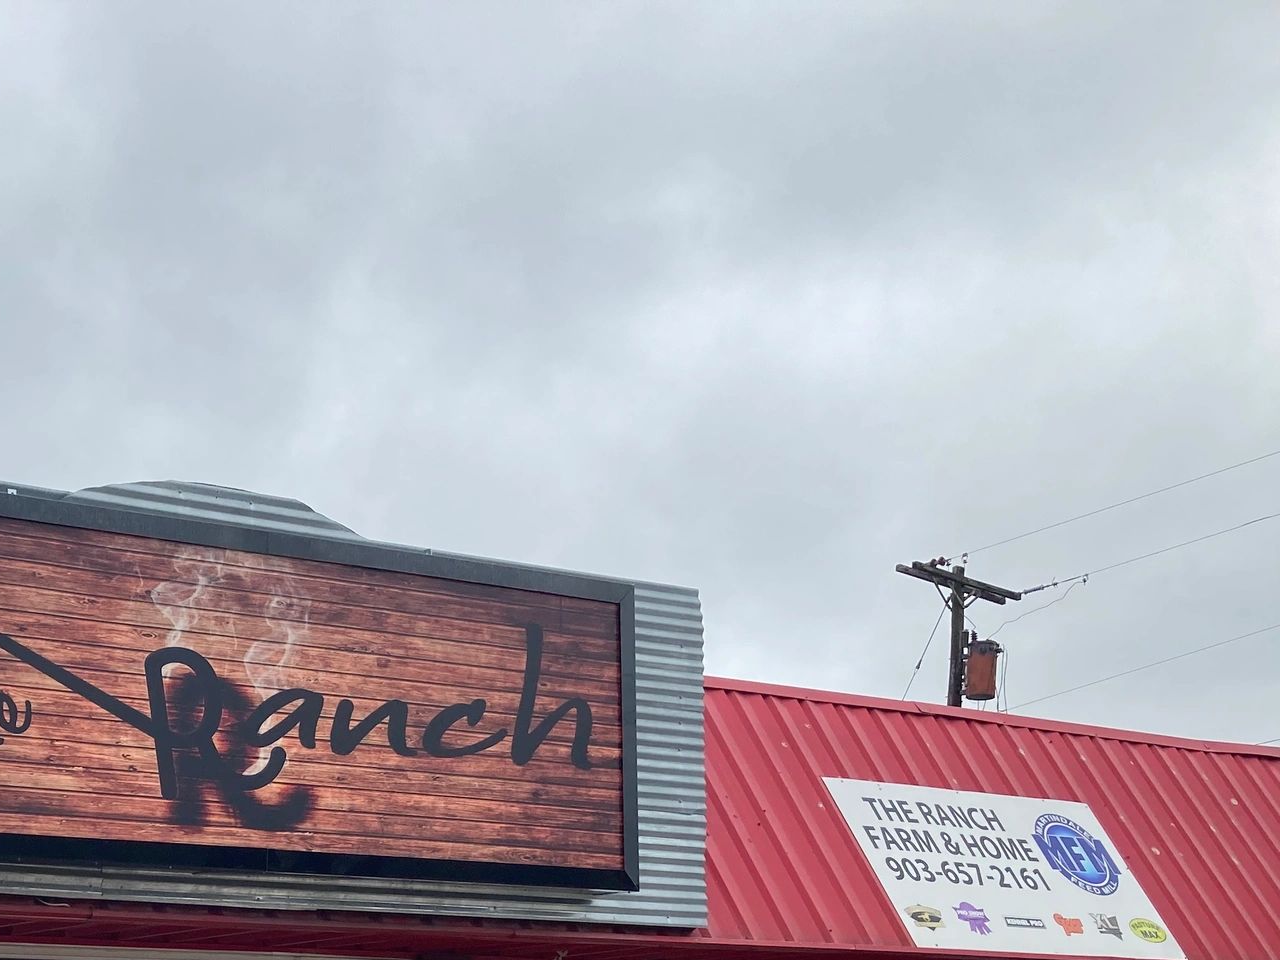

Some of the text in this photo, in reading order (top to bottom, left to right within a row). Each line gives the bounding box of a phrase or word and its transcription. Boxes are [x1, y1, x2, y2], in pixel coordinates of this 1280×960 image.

[144, 622, 594, 800] Ranch
[861, 797, 1006, 832] THE RANCH
[1035, 814, 1095, 841] MARTINDALE
[862, 825, 1040, 863] FARM & HOME
[1031, 834, 1121, 875] MFM
[885, 856, 1052, 892] 903-657-2161
[1071, 876, 1117, 894] FEED MILL
